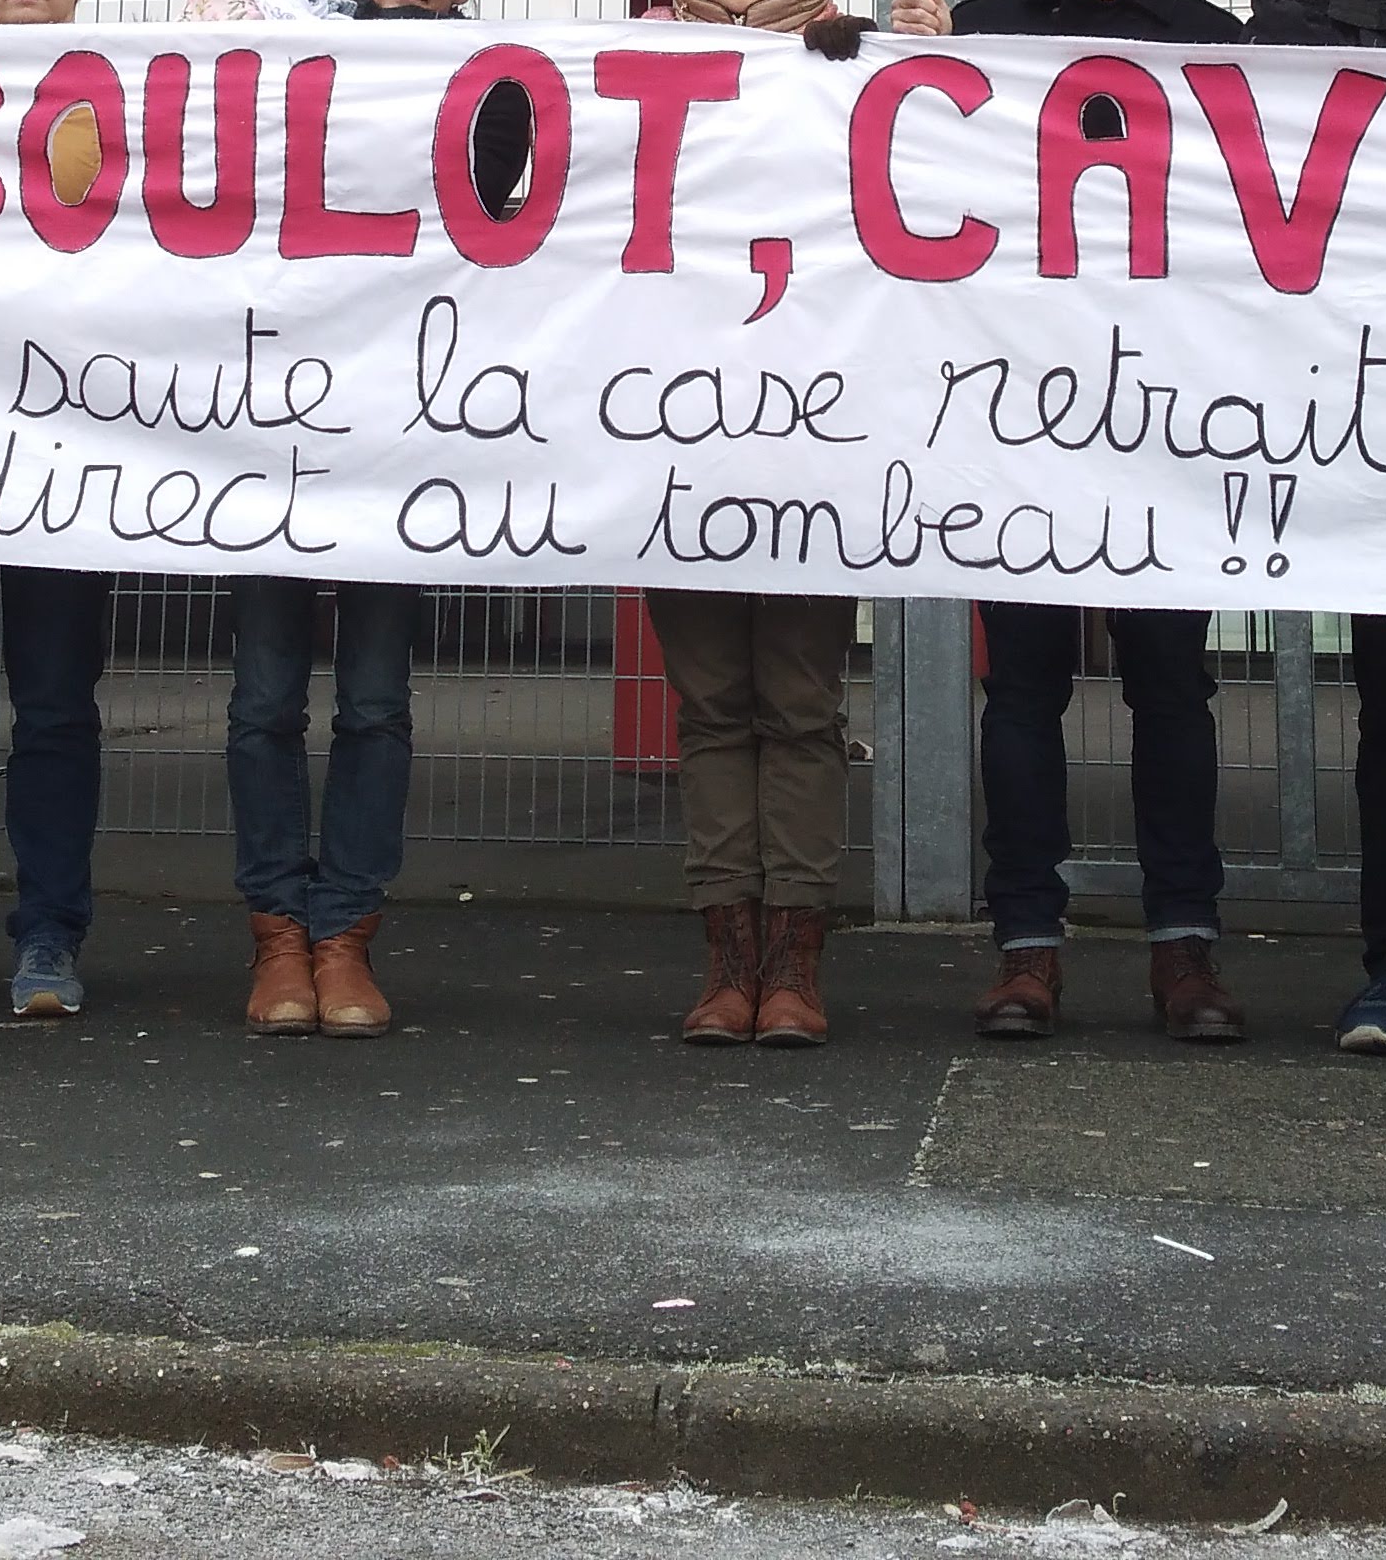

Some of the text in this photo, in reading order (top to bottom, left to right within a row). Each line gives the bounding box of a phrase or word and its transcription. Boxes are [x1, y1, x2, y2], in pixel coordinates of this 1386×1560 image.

[10, 306, 353, 434] saute
[402, 294, 549, 444] la
[597, 363, 870, 444] case
[395, 477, 588, 558] au
[635, 458, 1175, 575] tombeau
